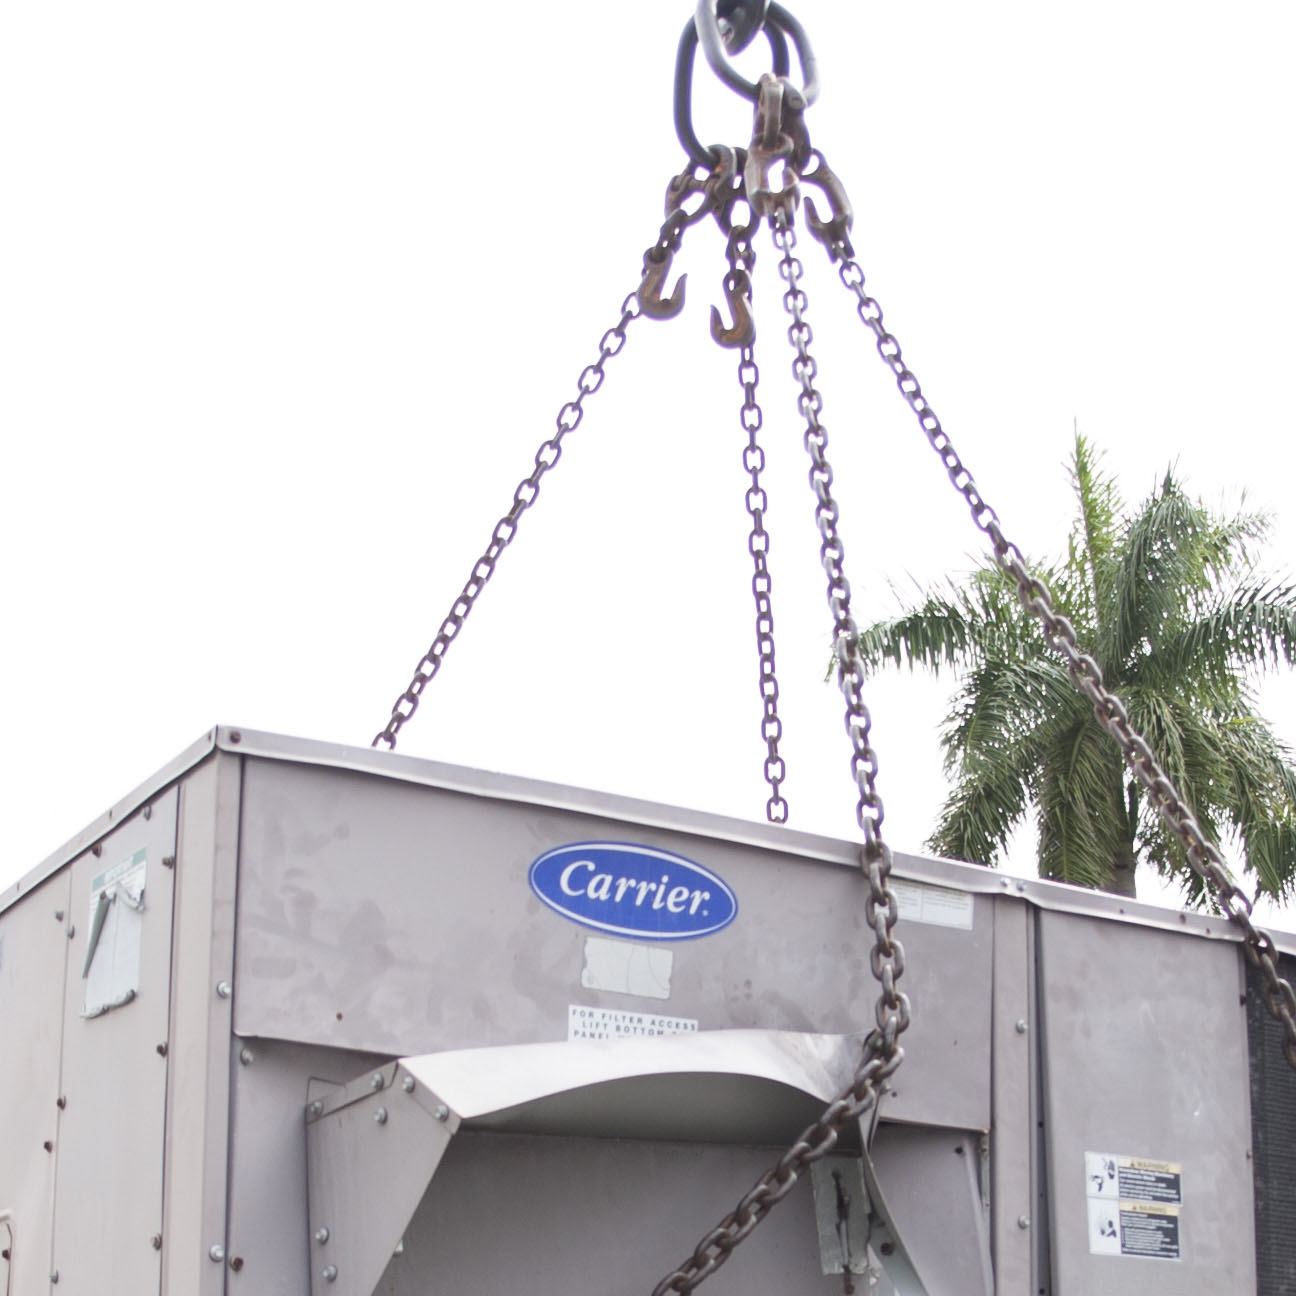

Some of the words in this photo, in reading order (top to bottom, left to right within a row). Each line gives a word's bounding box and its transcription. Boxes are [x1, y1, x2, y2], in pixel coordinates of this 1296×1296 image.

[559, 860, 711, 917] Carrier
[572, 1009, 595, 1019] FOR
[601, 1013, 644, 1025] FILTER
[650, 1019, 697, 1032] ACCESS
[582, 1020, 608, 1031] LIFT
